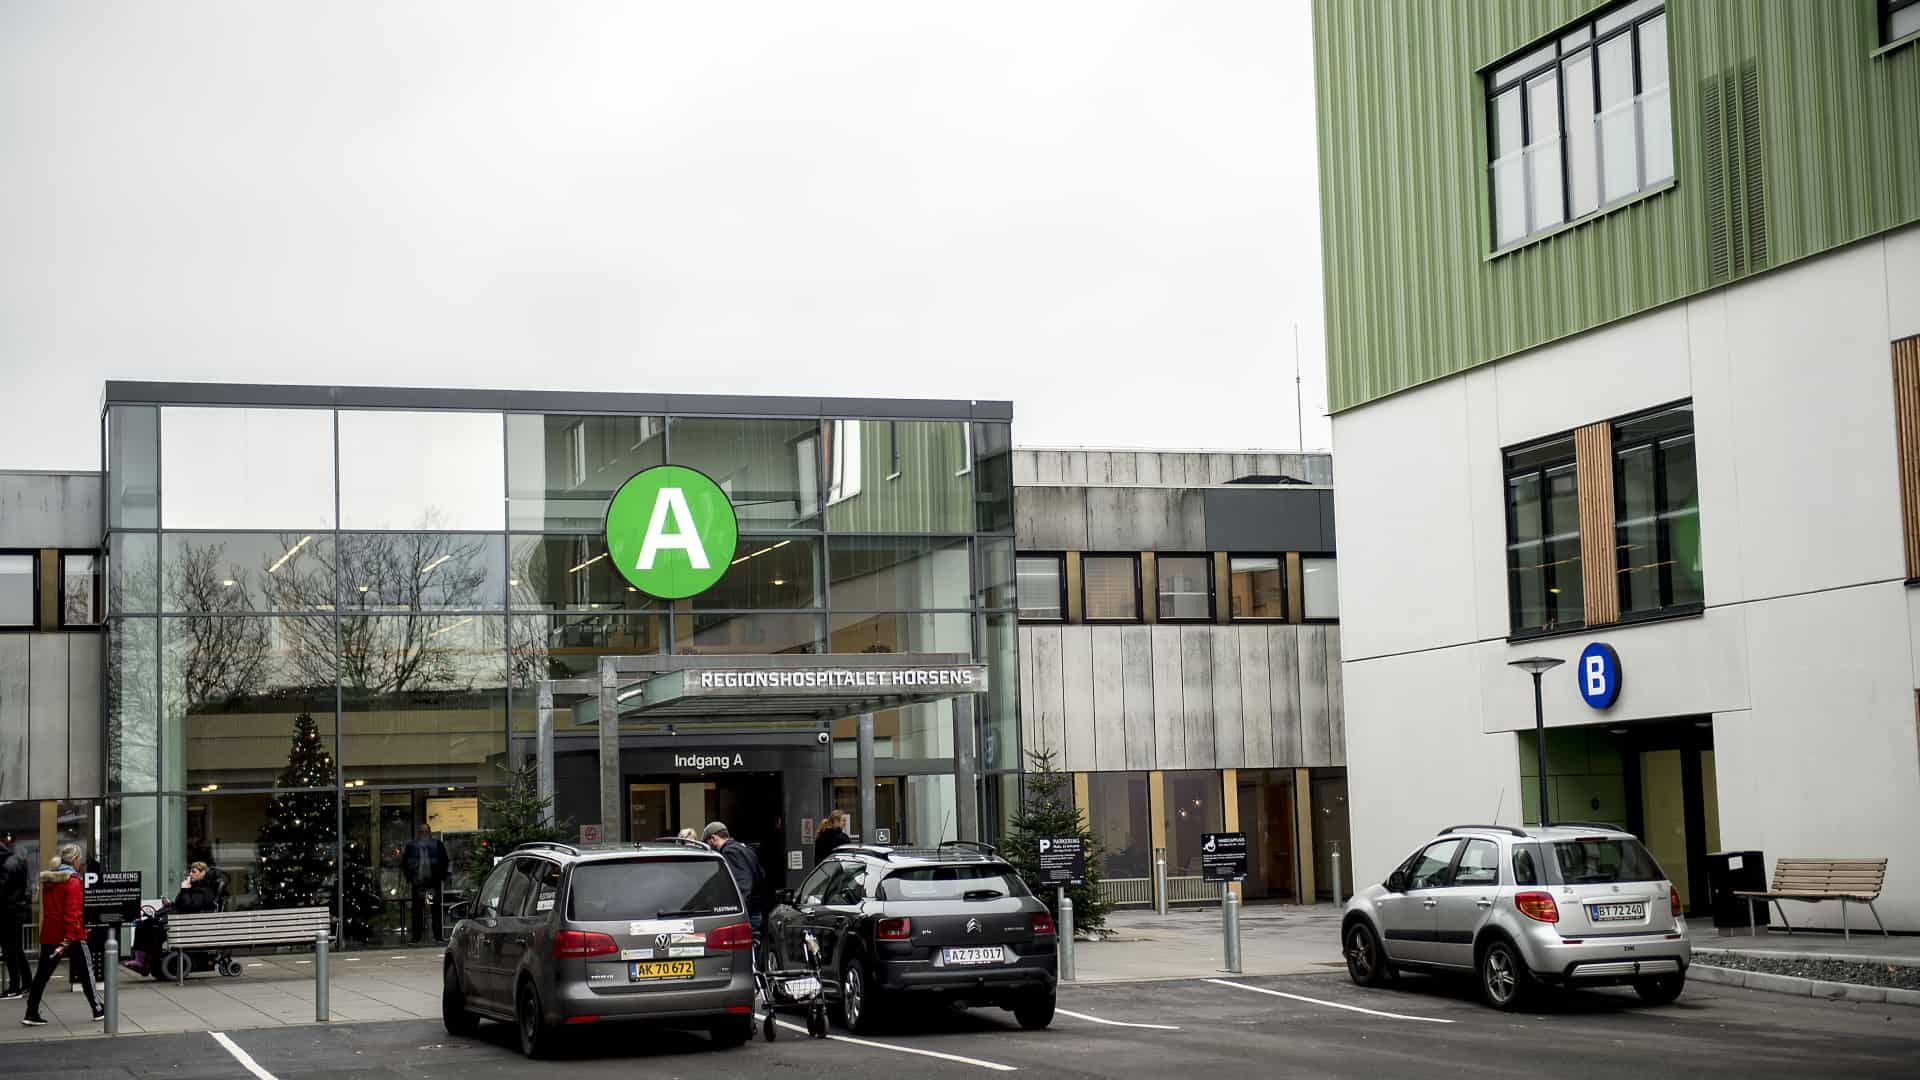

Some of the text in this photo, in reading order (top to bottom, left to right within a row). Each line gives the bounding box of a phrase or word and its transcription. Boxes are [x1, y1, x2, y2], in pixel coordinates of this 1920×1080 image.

[635, 487, 711, 570] A
[701, 670, 973, 688] REGIONSHOSPITALET HORSENS
[1586, 655, 1606, 696] B
[675, 753, 744, 769] Indgang A
[1040, 839, 1050, 853] P
[84, 872, 99, 889] P
[1599, 904, 1642, 916] BT 72 240
[952, 949, 1001, 960] AZ 73 017
[638, 962, 692, 976] AK 70 672
